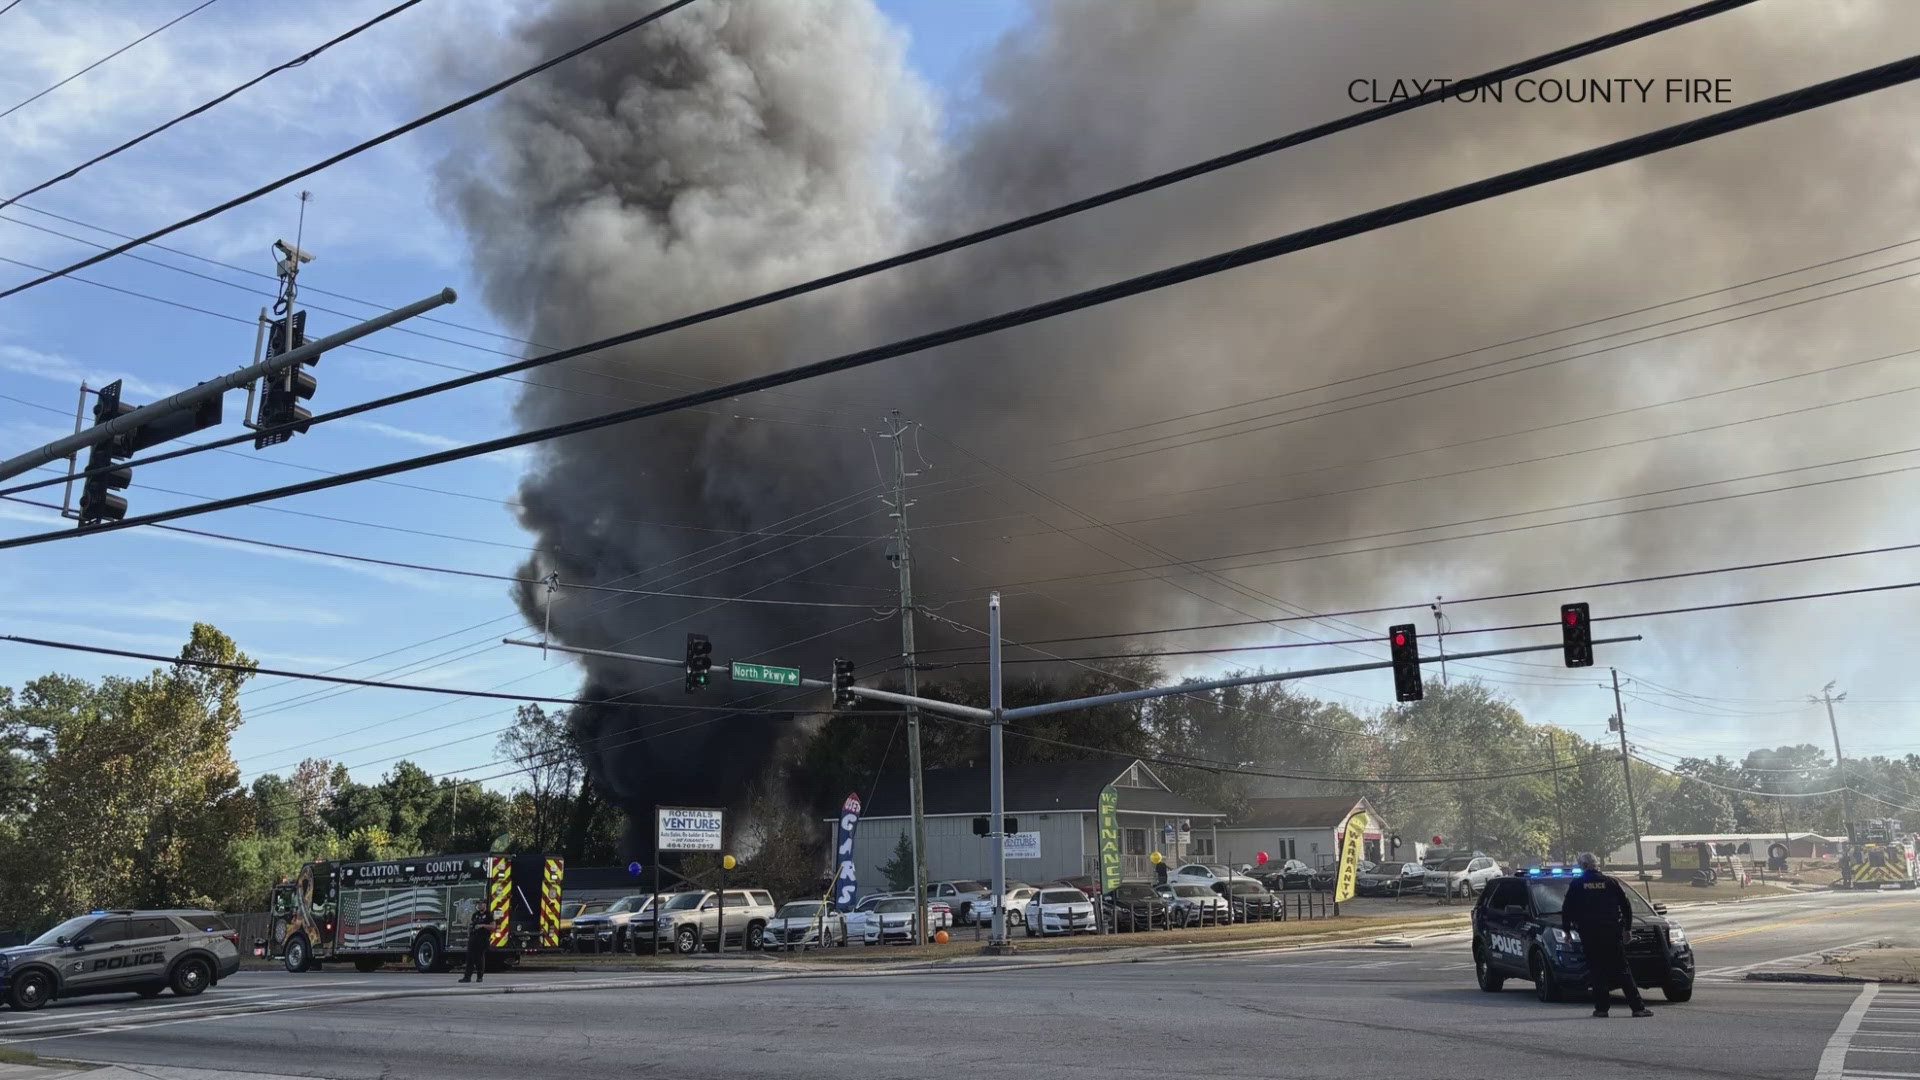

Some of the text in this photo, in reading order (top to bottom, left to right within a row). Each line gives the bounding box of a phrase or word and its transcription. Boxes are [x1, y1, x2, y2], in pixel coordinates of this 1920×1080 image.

[734, 666, 785, 683] North Pkwy
[1101, 793, 1116, 803] We
[669, 810, 713, 818] ROCMALS
[663, 818, 721, 829] VENTURES
[1101, 805, 1120, 889] FINANCE
[838, 814, 857, 904] CARS
[1342, 831, 1358, 898] WARRANTY
[360, 861, 464, 877] CLAYTON COUNTY
[1491, 933, 1523, 956] POLICE
[94, 952, 166, 971] POLICE
